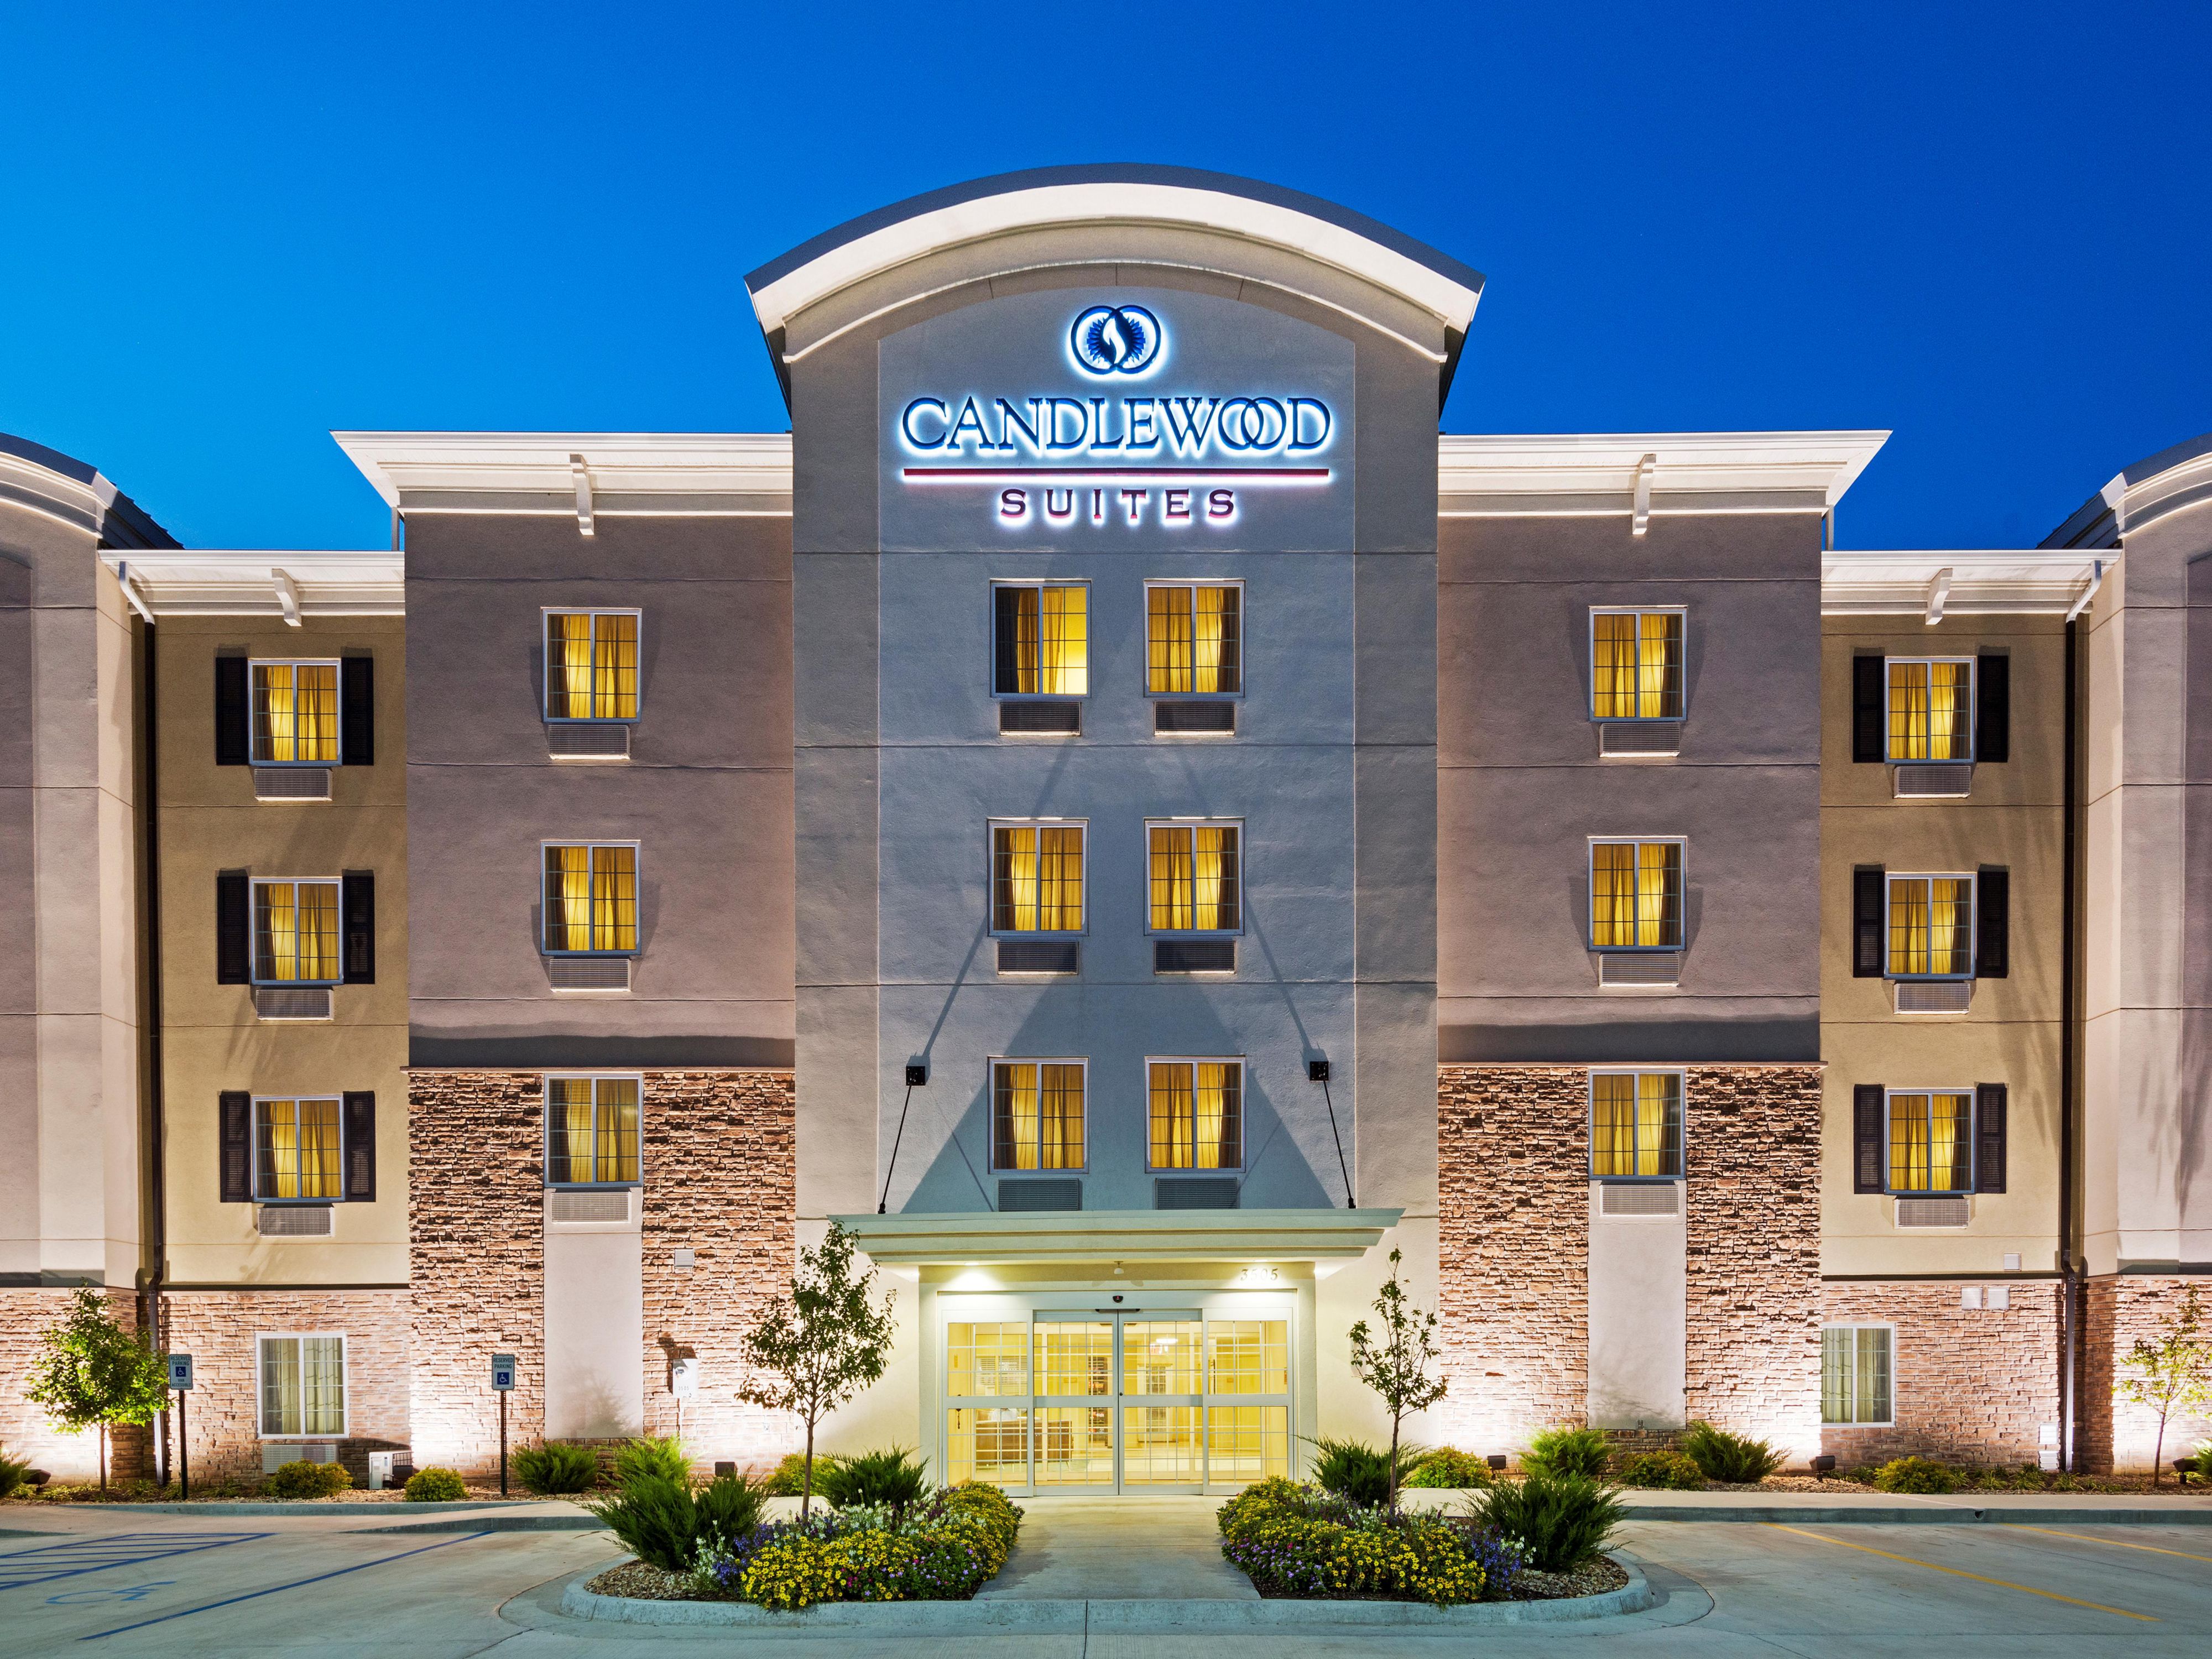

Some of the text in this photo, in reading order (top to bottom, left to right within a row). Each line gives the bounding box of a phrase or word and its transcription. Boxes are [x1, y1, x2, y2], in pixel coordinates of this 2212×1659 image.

[902, 395, 1331, 451] CANDLEWOOD
[1000, 488, 1235, 519] SUITES
[1240, 1268, 1279, 1281] 3505
